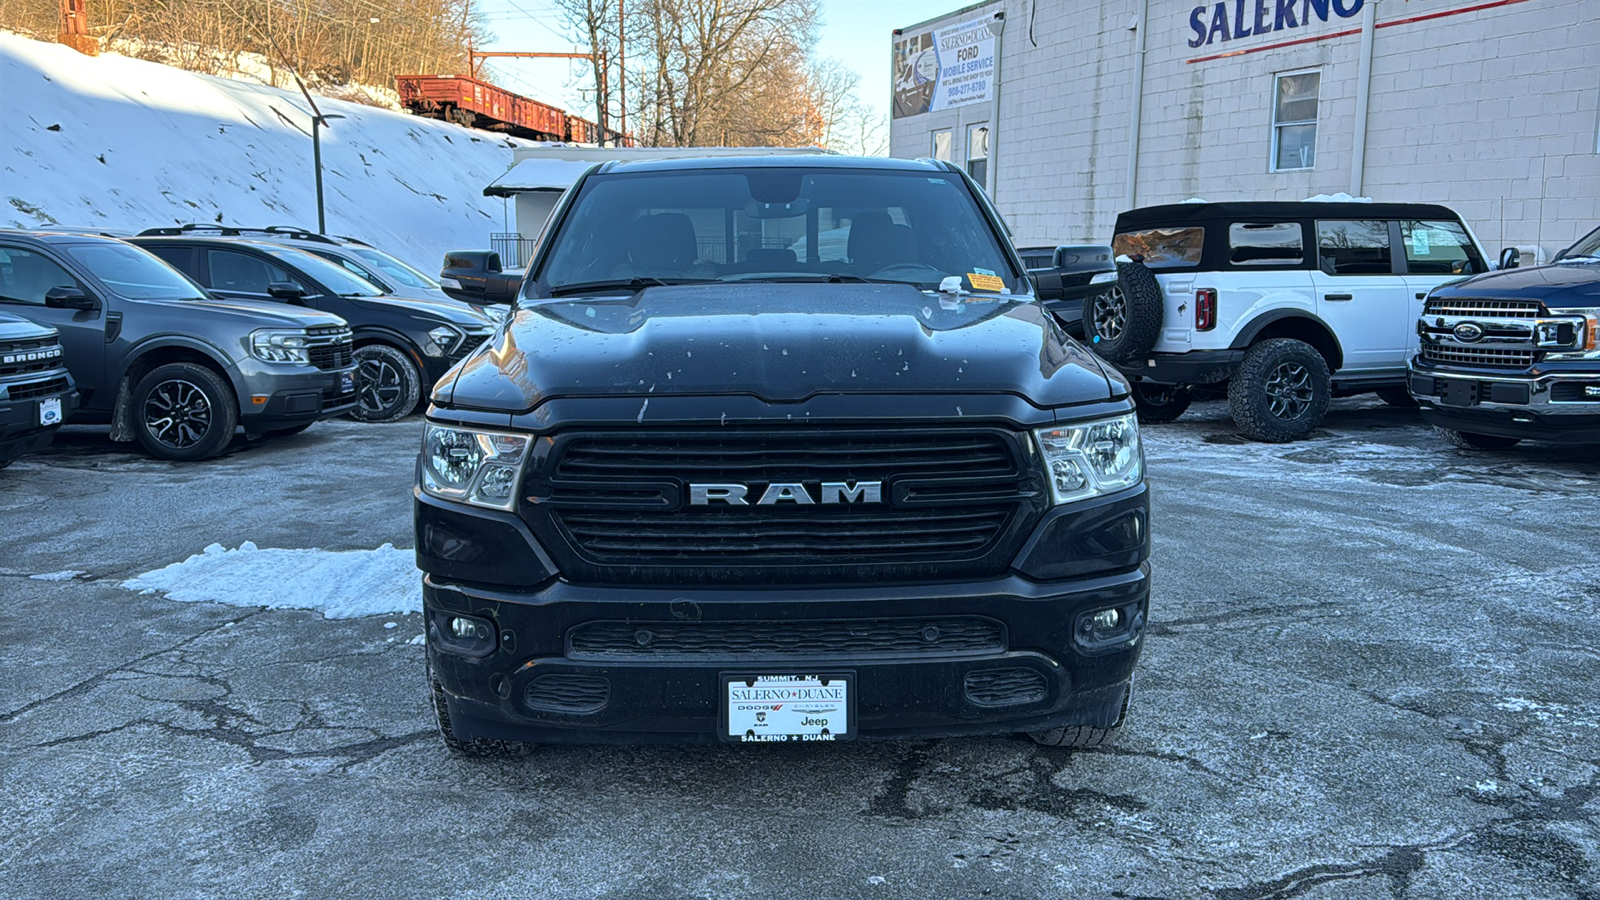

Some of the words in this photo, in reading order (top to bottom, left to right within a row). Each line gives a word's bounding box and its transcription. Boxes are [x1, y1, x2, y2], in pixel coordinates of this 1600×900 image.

[957, 46, 979, 63] FORD
[943, 63, 966, 78] MOBILE
[967, 56, 993, 72] SERVICE
[3, 349, 61, 364] BRONCO
[689, 481, 882, 506] RAM
[732, 689, 791, 700] SALERNO
[798, 688, 843, 700] DUANE
[800, 716, 828, 727] Jeep
[741, 734, 788, 742] SALERNO
[802, 733, 836, 741] DUANE
